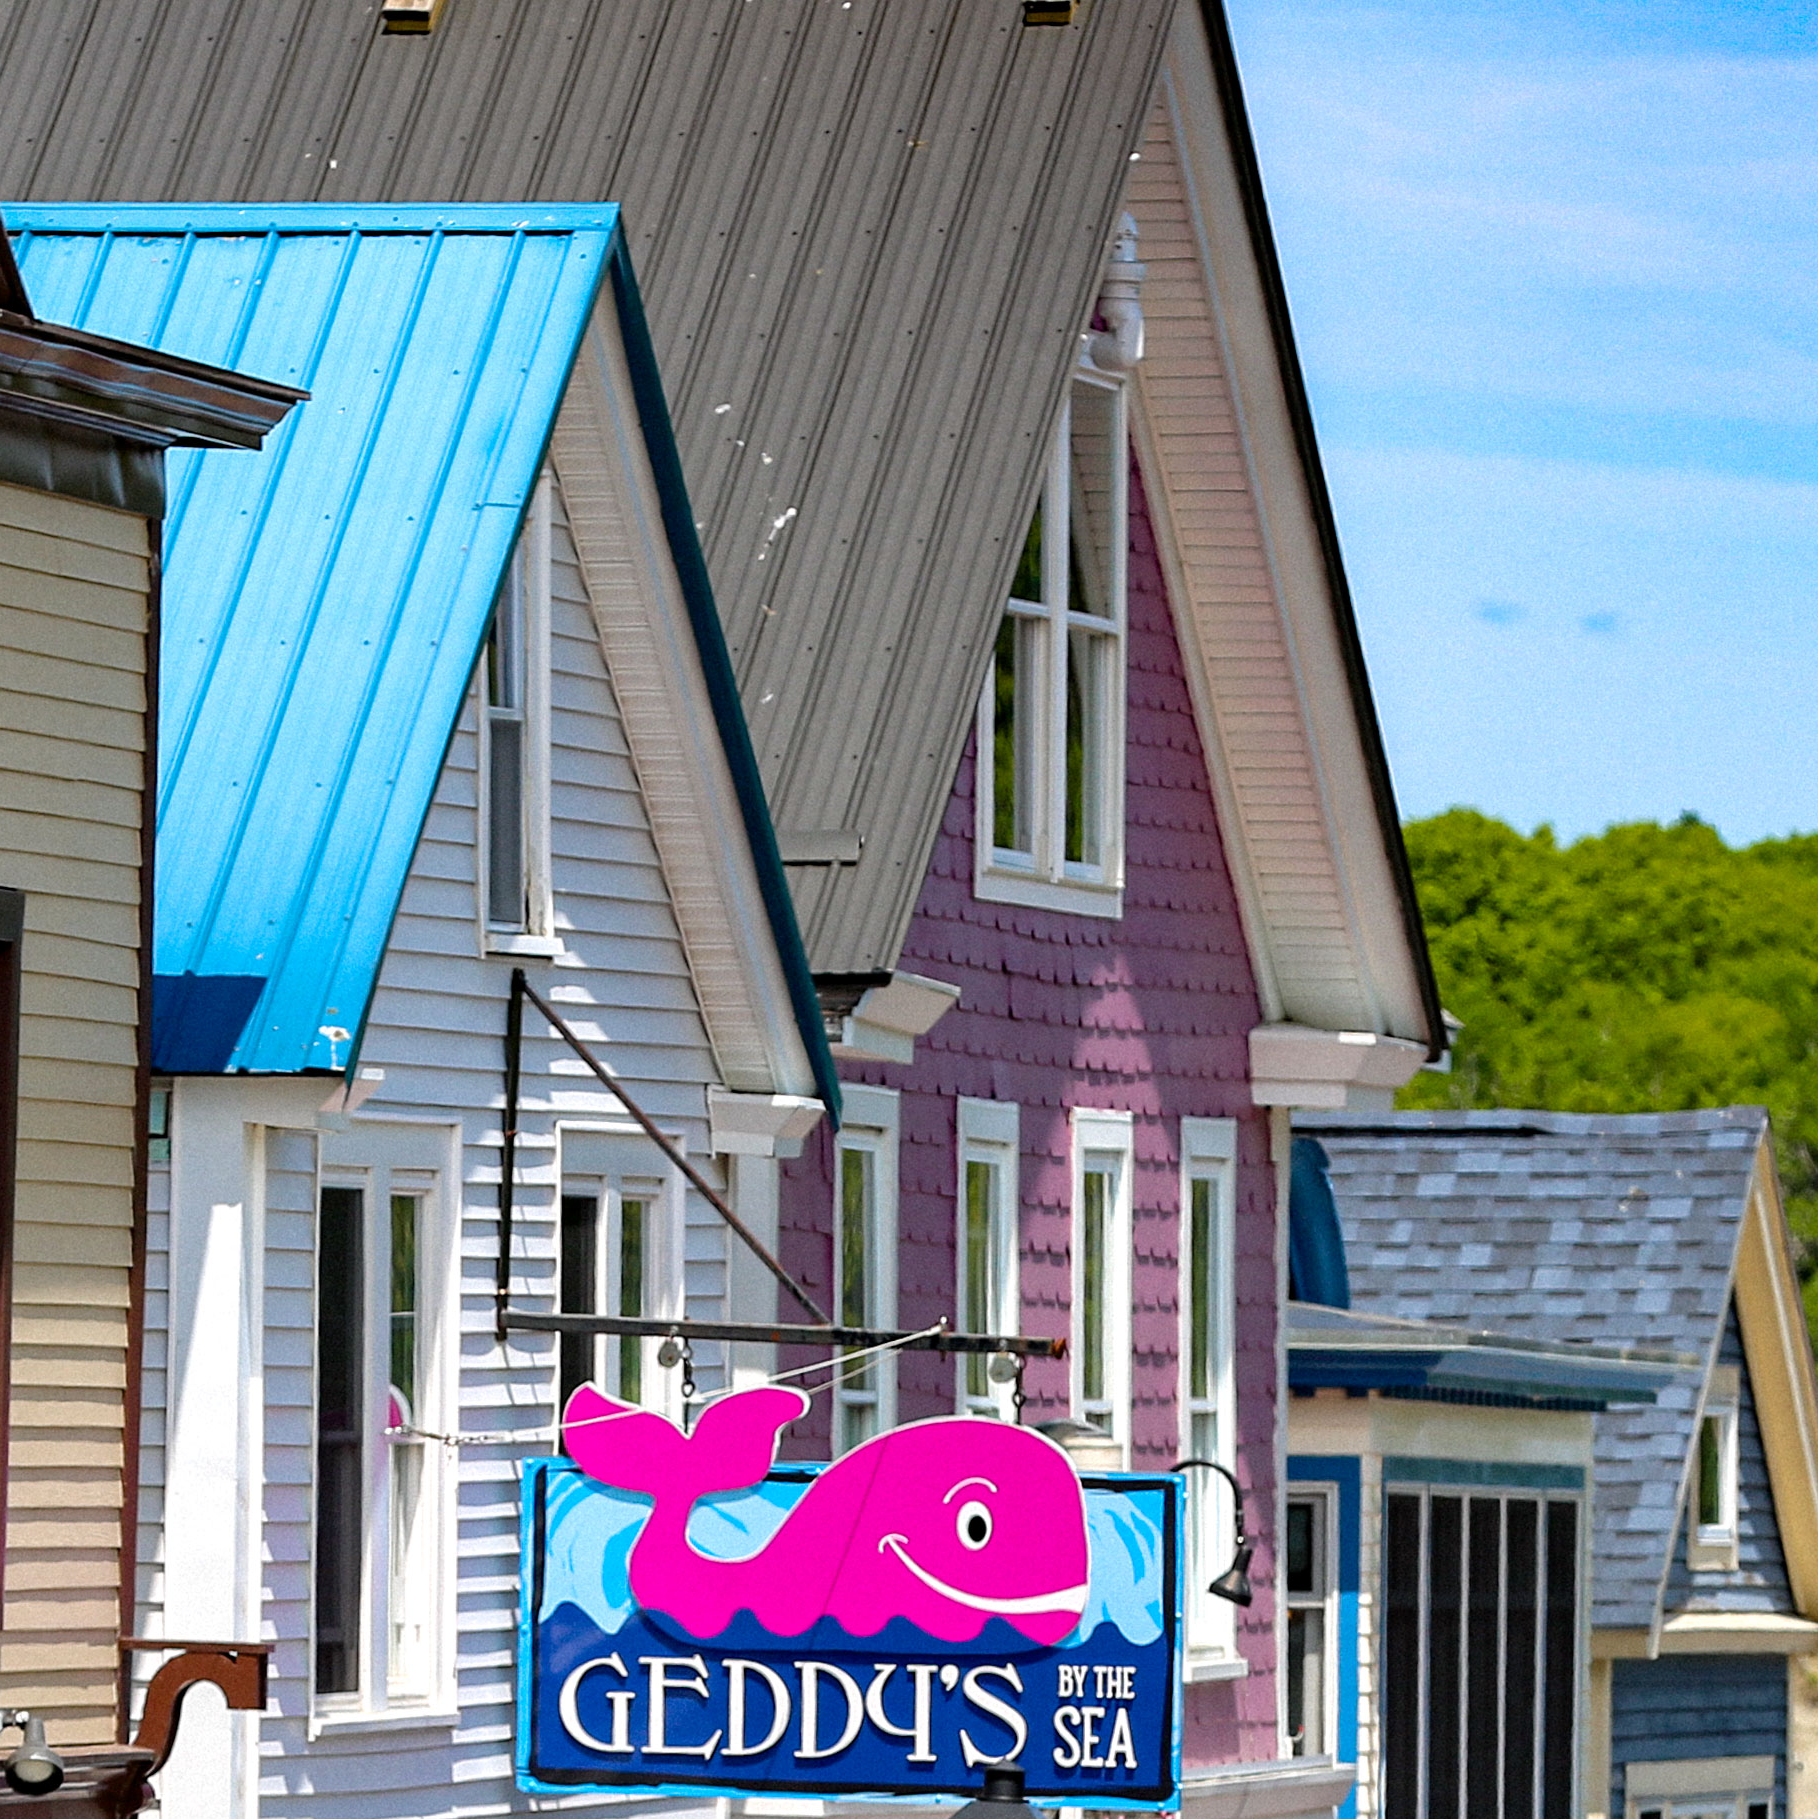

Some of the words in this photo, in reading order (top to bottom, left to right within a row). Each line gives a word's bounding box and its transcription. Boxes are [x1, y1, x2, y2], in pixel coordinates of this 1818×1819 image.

[558, 1653, 1028, 1766] GEDDY'S
[1058, 1664, 1088, 1698] BY
[1094, 1665, 1136, 1700] THE
[1053, 1705, 1138, 1770] SEA
